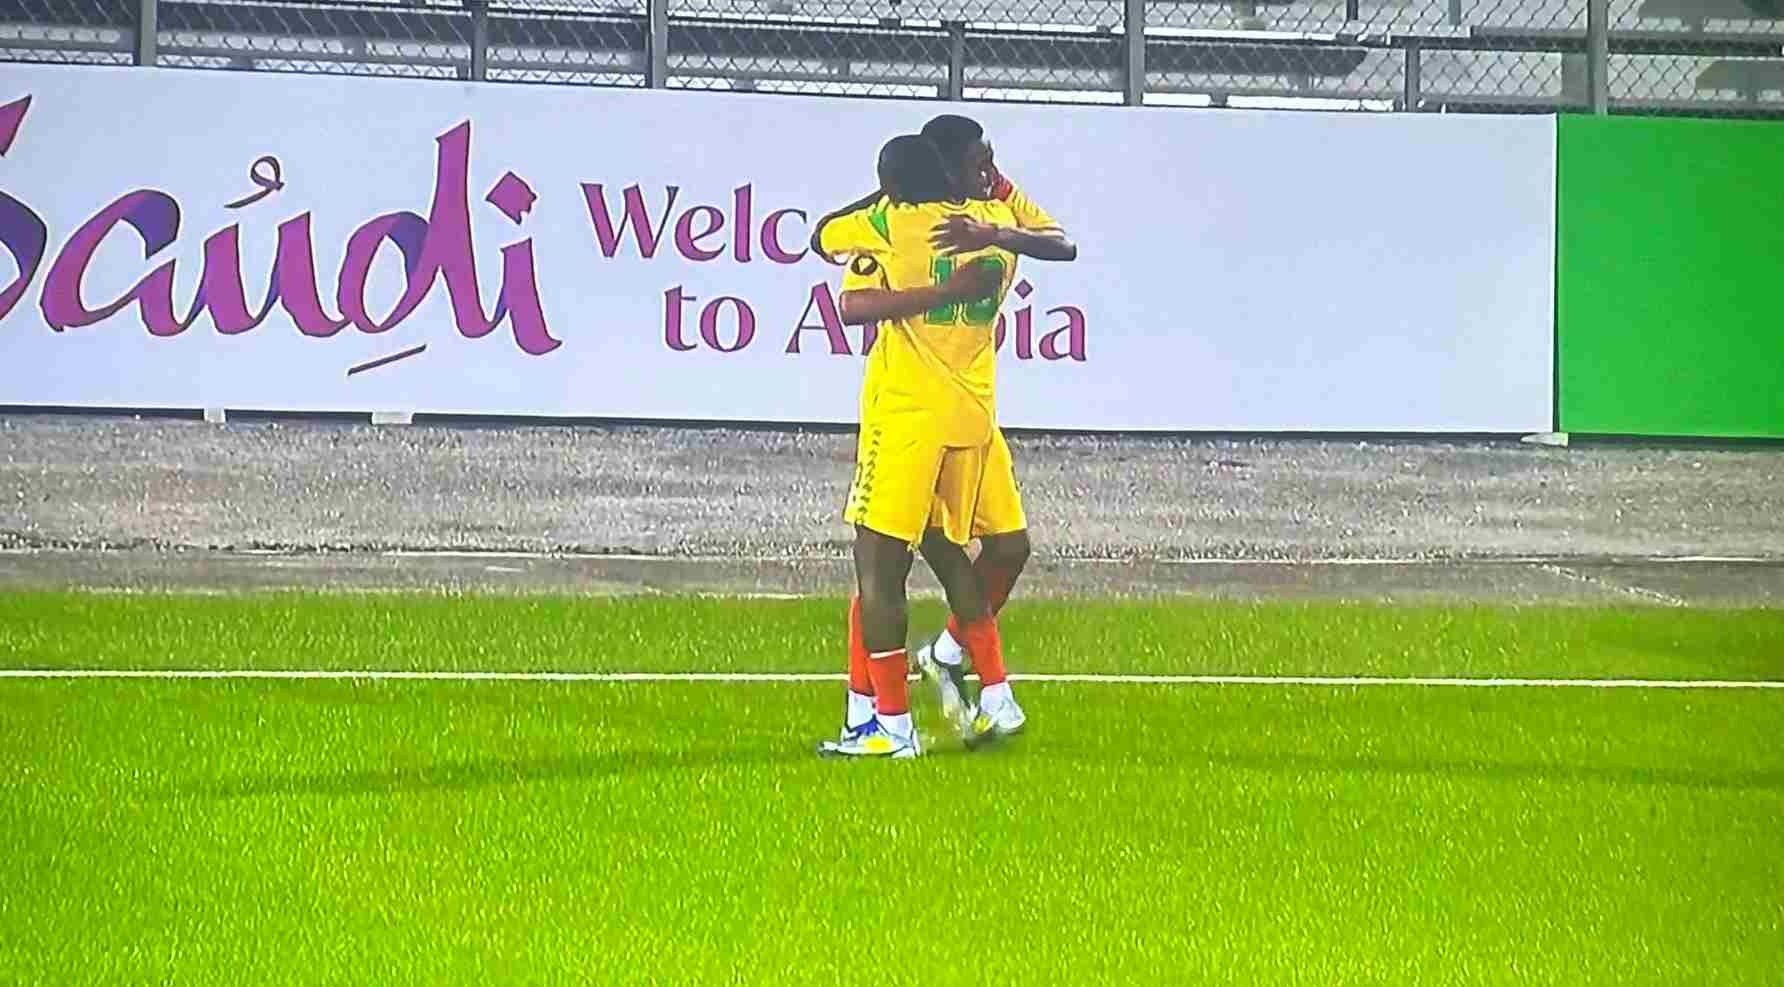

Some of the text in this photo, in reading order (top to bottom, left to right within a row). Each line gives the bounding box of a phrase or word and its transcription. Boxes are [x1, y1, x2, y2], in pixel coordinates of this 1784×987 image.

[579, 182, 810, 265] Welc
[663, 279, 1088, 363] to Aia
